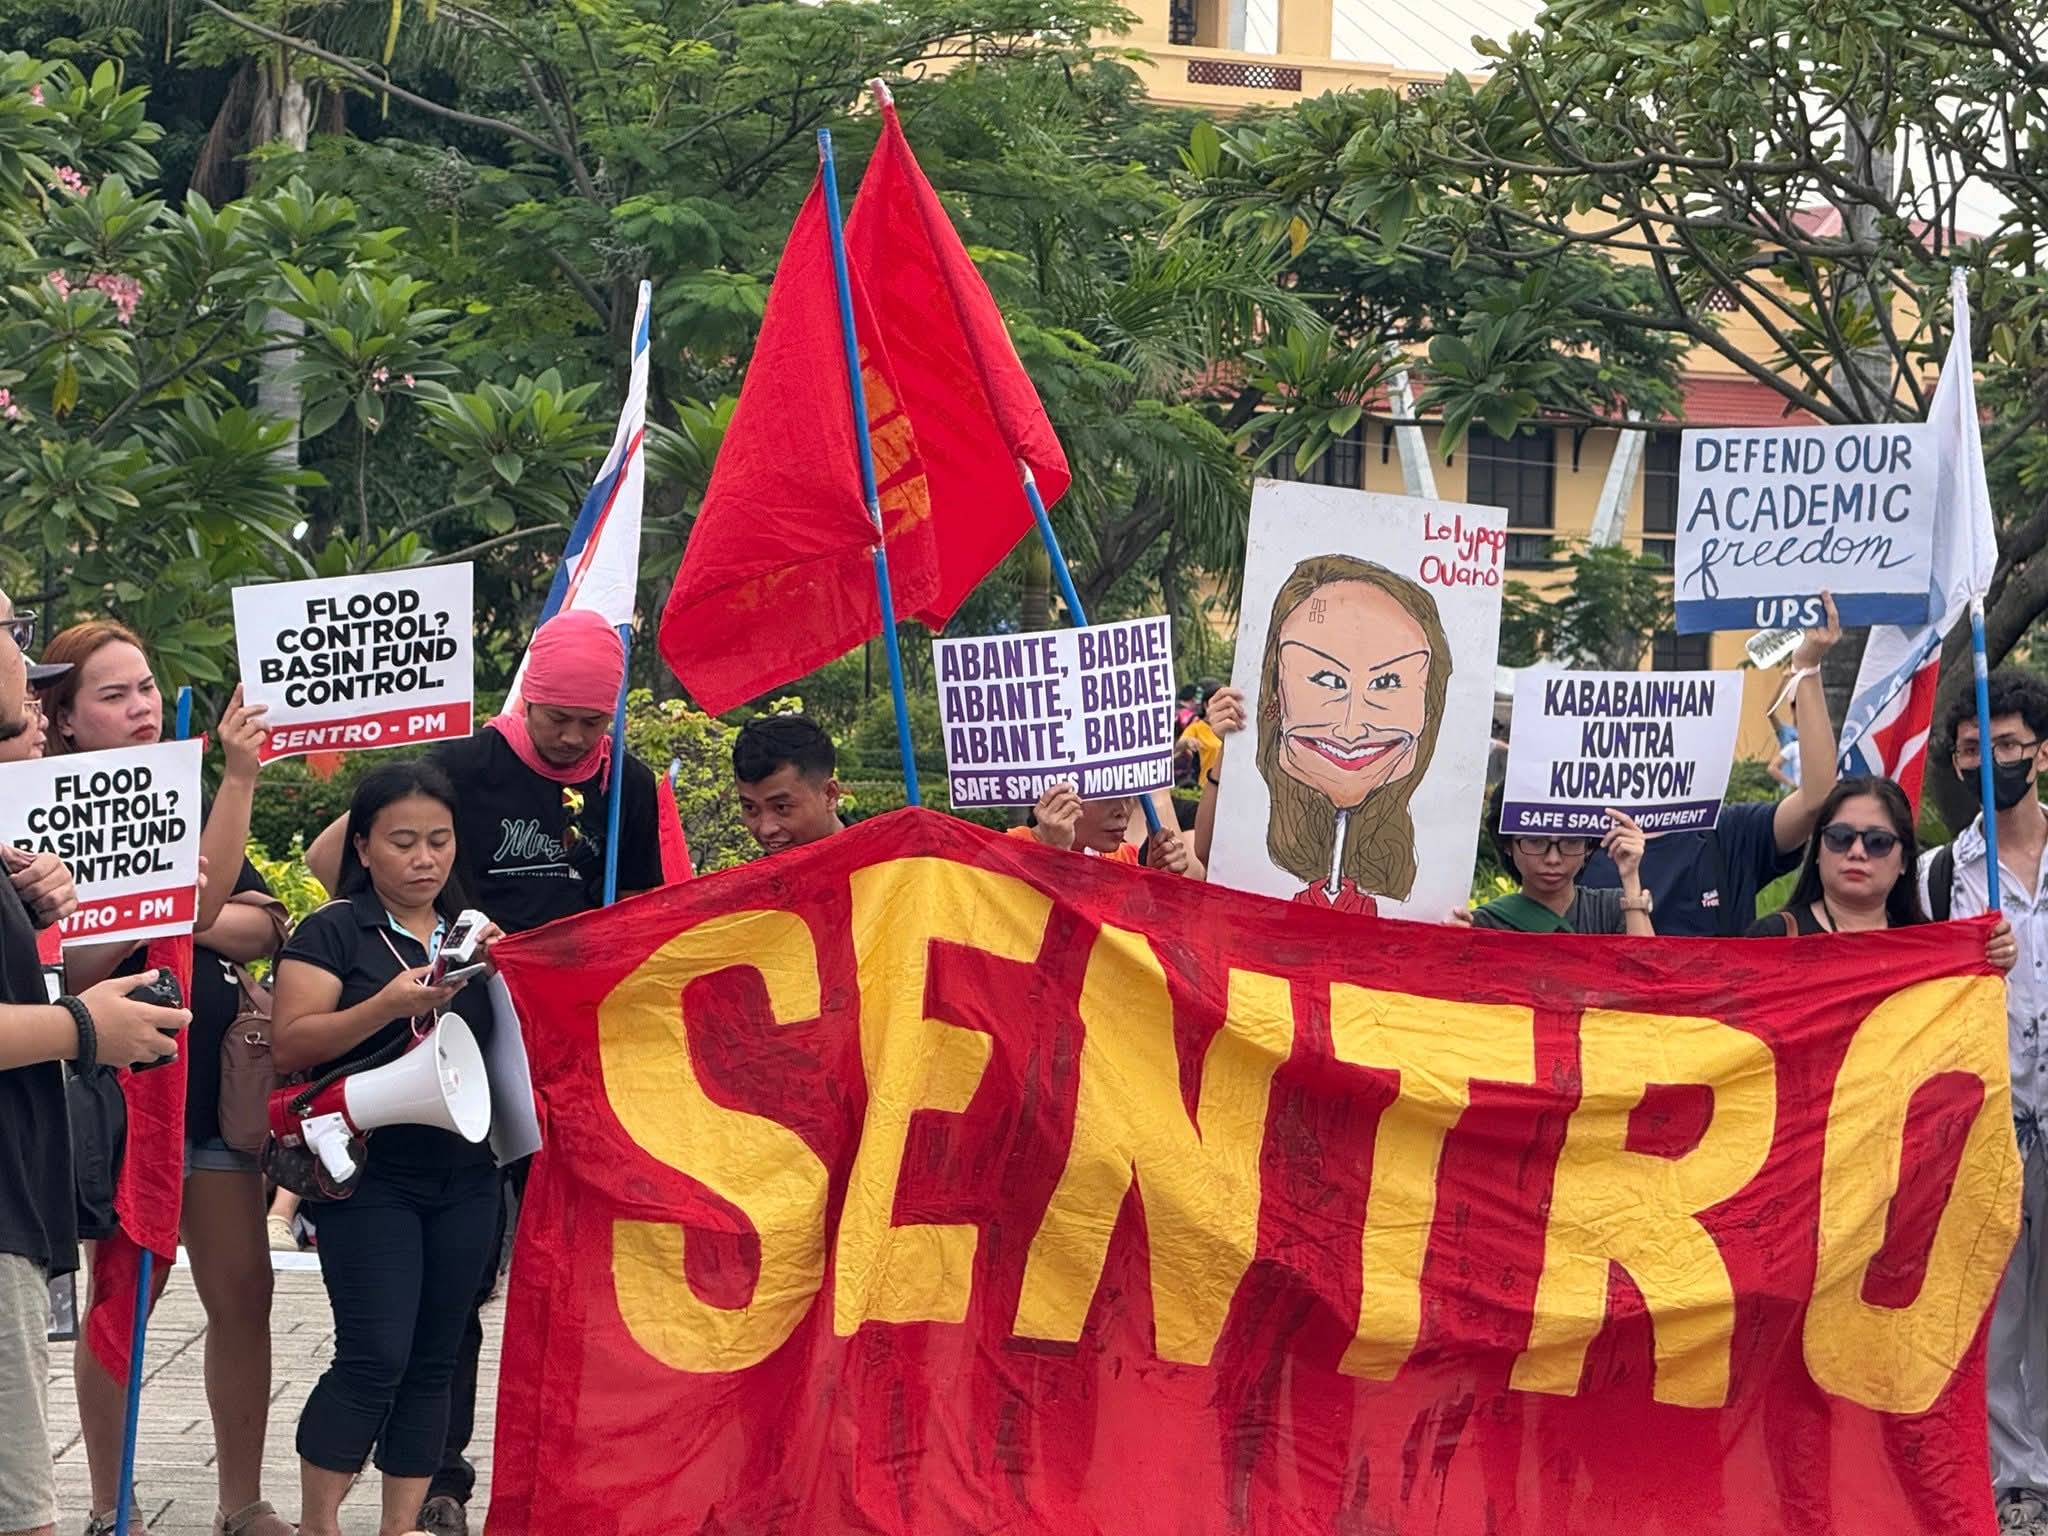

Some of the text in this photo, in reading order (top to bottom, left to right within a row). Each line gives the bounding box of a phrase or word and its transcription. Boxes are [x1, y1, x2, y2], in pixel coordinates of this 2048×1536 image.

[1695, 434, 1912, 474] DEFEND OUR
[1686, 483, 1912, 533] ACADEMIC
[1683, 525, 1918, 600] freedom
[306, 589, 420, 624] FLOOD
[1756, 597, 1822, 628] UPS
[276, 611, 449, 654] CONTROL?
[942, 621, 1167, 682] ABANTE, BABAE!
[260, 637, 457, 684] BASIN FUND
[285, 666, 444, 708] CONTROL.
[946, 663, 1171, 723] ABANTE, BABAE!
[1544, 679, 1715, 717] KABABAINHAN
[271, 721, 382, 751] SENTRO
[408, 712, 446, 735] PM
[951, 705, 1172, 764] ABANTE, BABAE!
[1581, 721, 1674, 758] KUNTRA
[55, 766, 152, 802] FLOOD
[954, 777, 1000, 802] SAFE
[1084, 757, 1172, 794] MOVEMENT
[1549, 761, 1696, 800] KURAPSYON!
[28, 790, 179, 834] CONTROL?
[1520, 808, 1707, 830] SAFE SPACE MOVEMENT
[112, 818, 186, 851] FUND
[63, 848, 173, 884] NTROL.
[139, 896, 173, 921] PM
[597, 856, 2024, 1415] SENTRO
